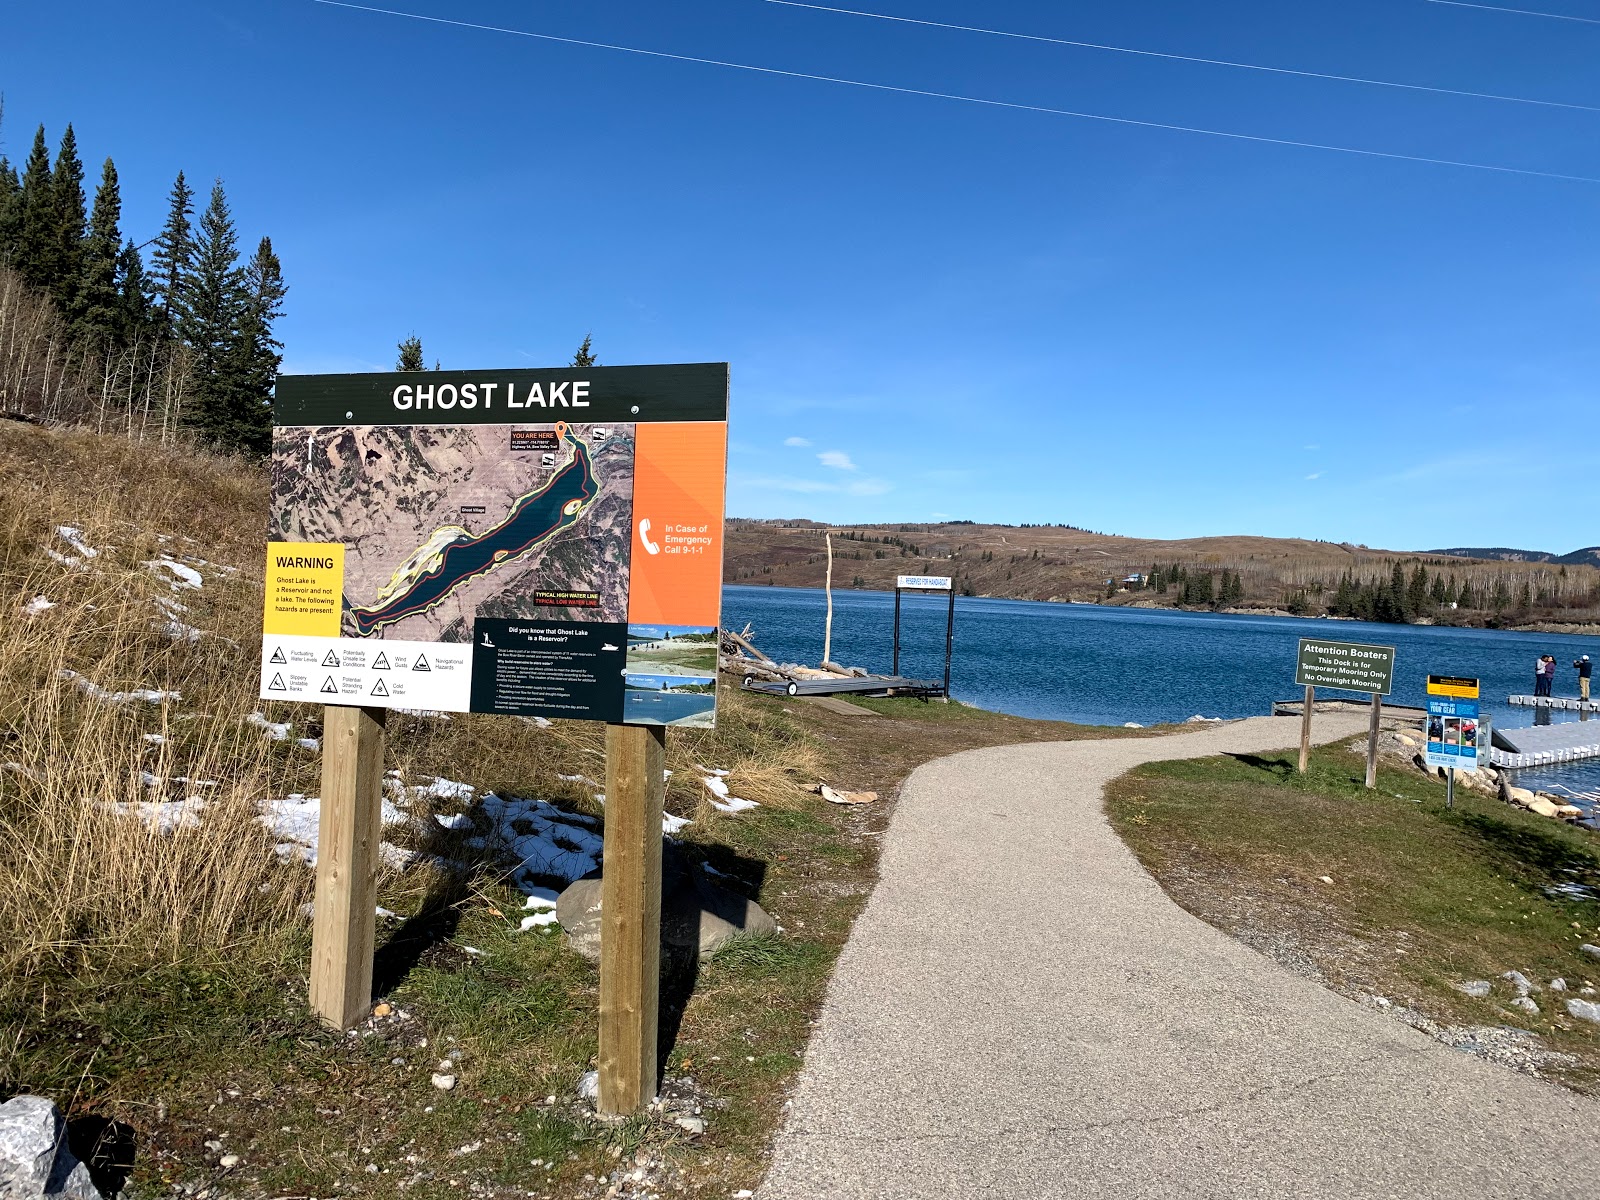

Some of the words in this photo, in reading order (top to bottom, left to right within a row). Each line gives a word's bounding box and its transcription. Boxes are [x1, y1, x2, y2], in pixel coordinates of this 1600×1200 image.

[392, 383, 498, 410] GHOST
[508, 381, 590, 408] LAKE
[665, 535, 712, 545] Emergency
[276, 556, 334, 569] WARNING
[307, 597, 334, 605] following
[1304, 644, 1347, 656] Attention
[1350, 648, 1388, 660] Boaters
[1302, 663, 1337, 674] Temporary
[1339, 667, 1368, 678] Mooring
[1370, 670, 1386, 679] Only
[1316, 675, 1350, 685] Overnight
[1352, 679, 1381, 689] Mooring
